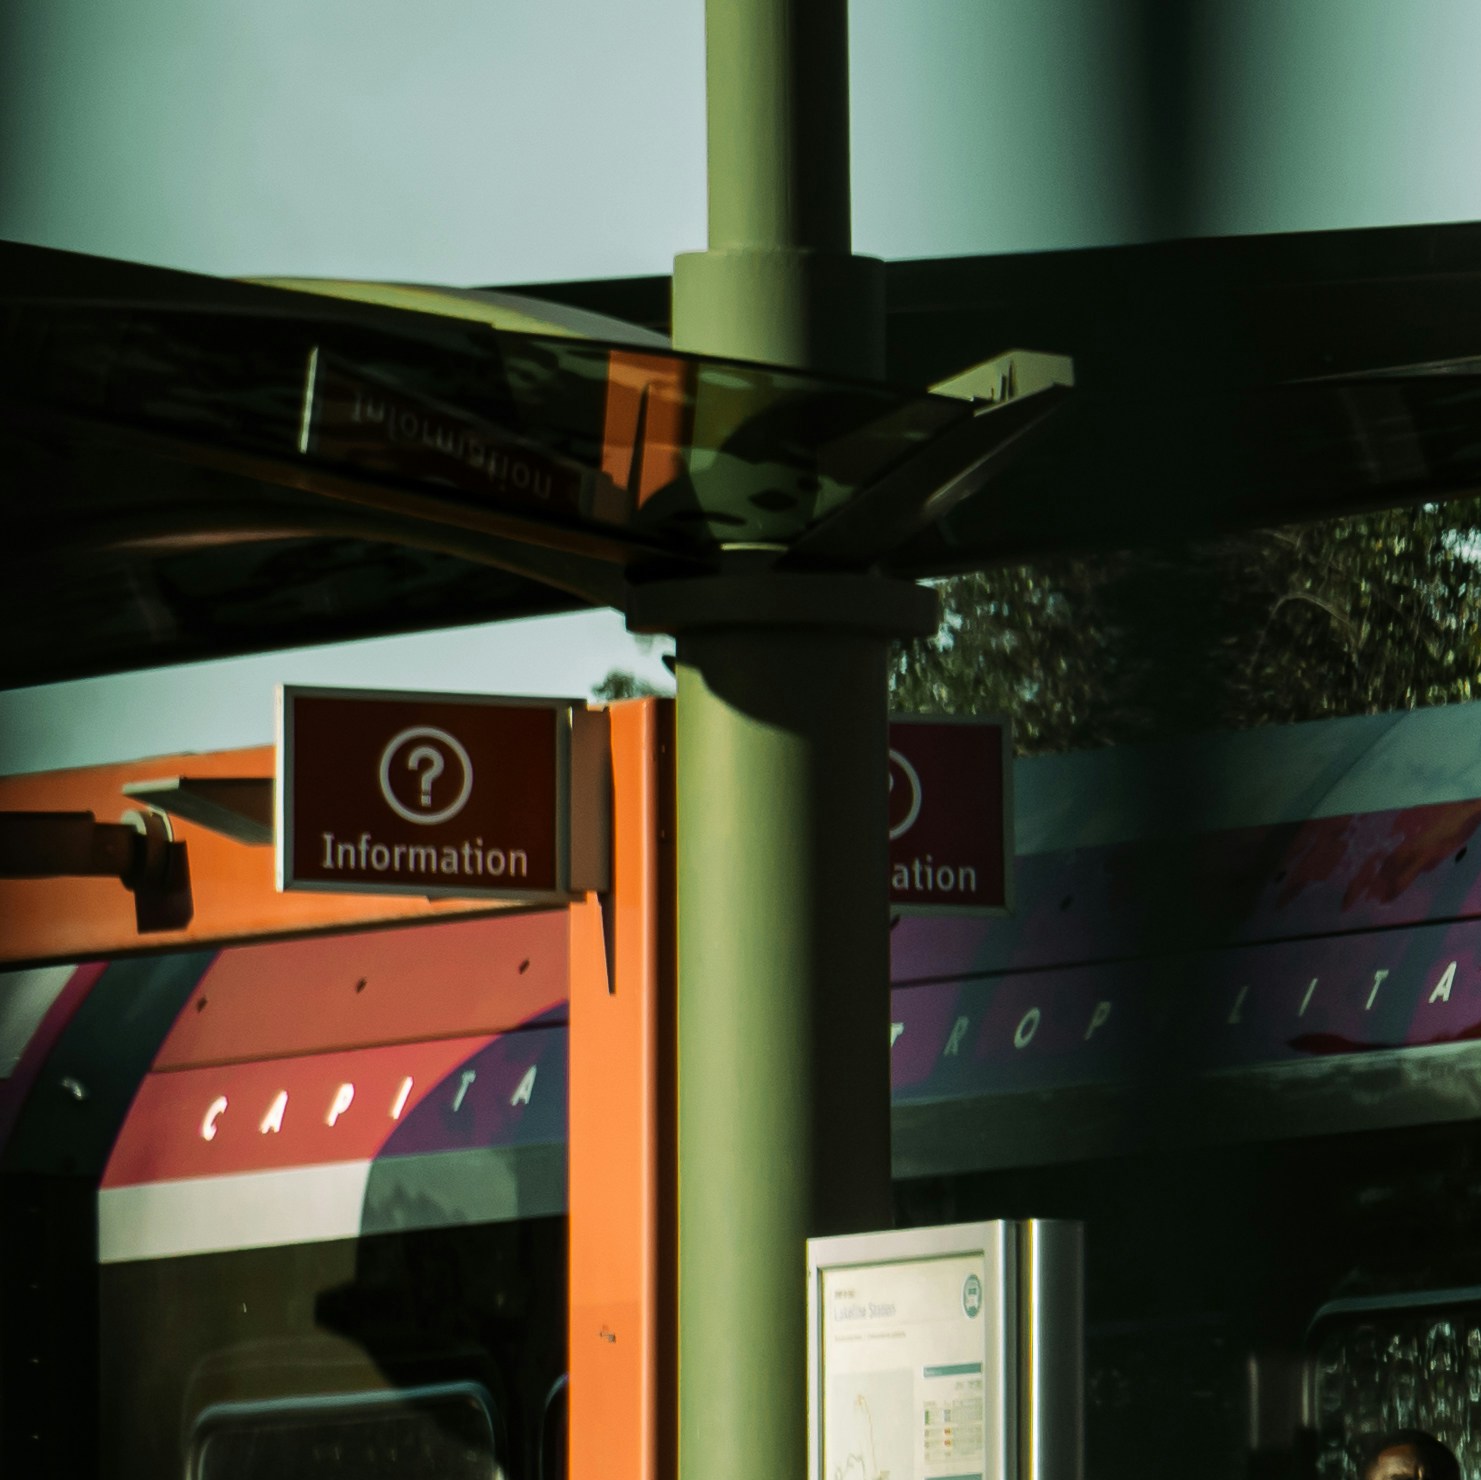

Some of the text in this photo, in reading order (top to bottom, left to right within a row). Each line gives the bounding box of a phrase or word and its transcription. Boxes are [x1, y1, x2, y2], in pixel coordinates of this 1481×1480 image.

[321, 831, 528, 878] Information
[891, 854, 978, 892] ation
[201, 1065, 538, 1142] CAPITA
